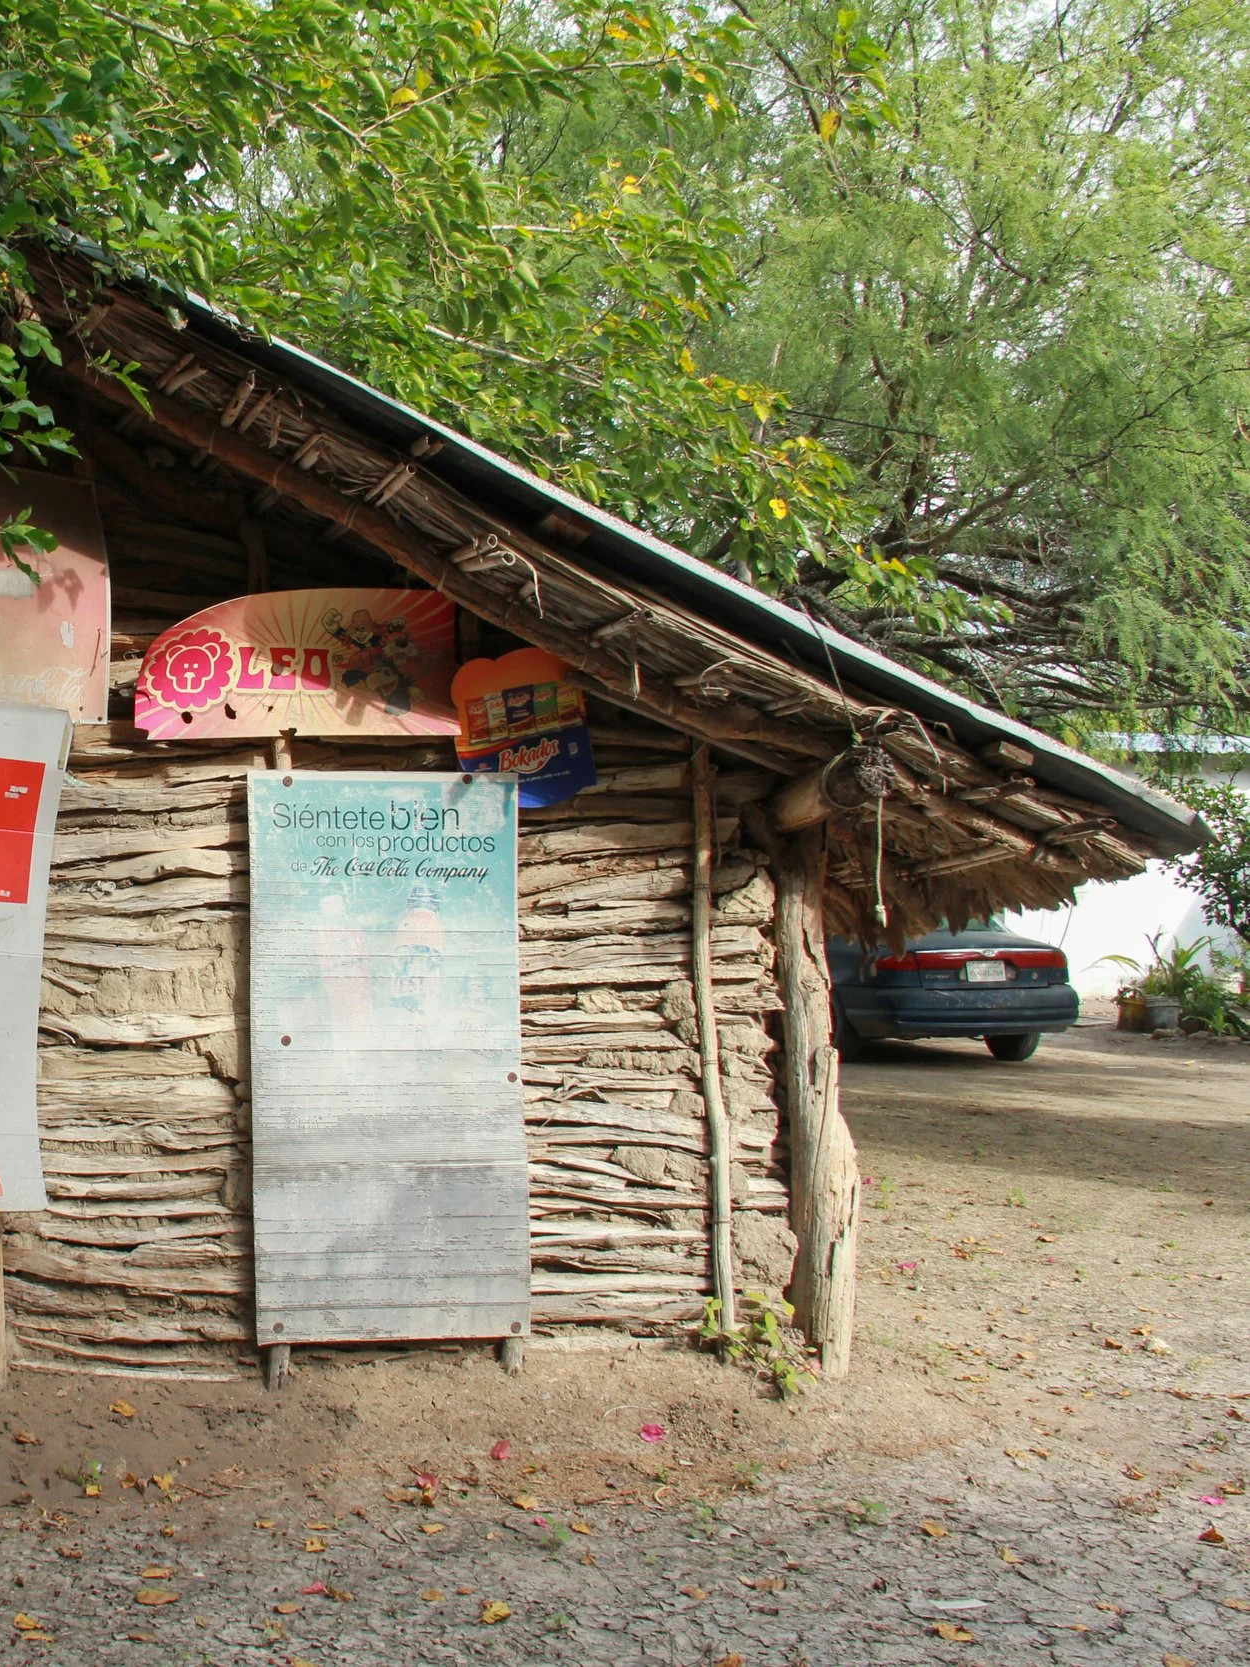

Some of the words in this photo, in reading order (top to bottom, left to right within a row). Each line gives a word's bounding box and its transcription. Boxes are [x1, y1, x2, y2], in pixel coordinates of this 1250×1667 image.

[237, 646, 331, 691] LEO
[499, 738, 561, 773] Bokados
[273, 803, 384, 829] Siéntete
[390, 801, 460, 831] bien
[316, 834, 346, 848] con
[352, 833, 375, 848] los
[377, 832, 496, 856] productos
[291, 860, 307, 872] de
[310, 856, 339, 877] The
[344, 857, 409, 877] Coca-Cola
[415, 858, 490, 883] Company
